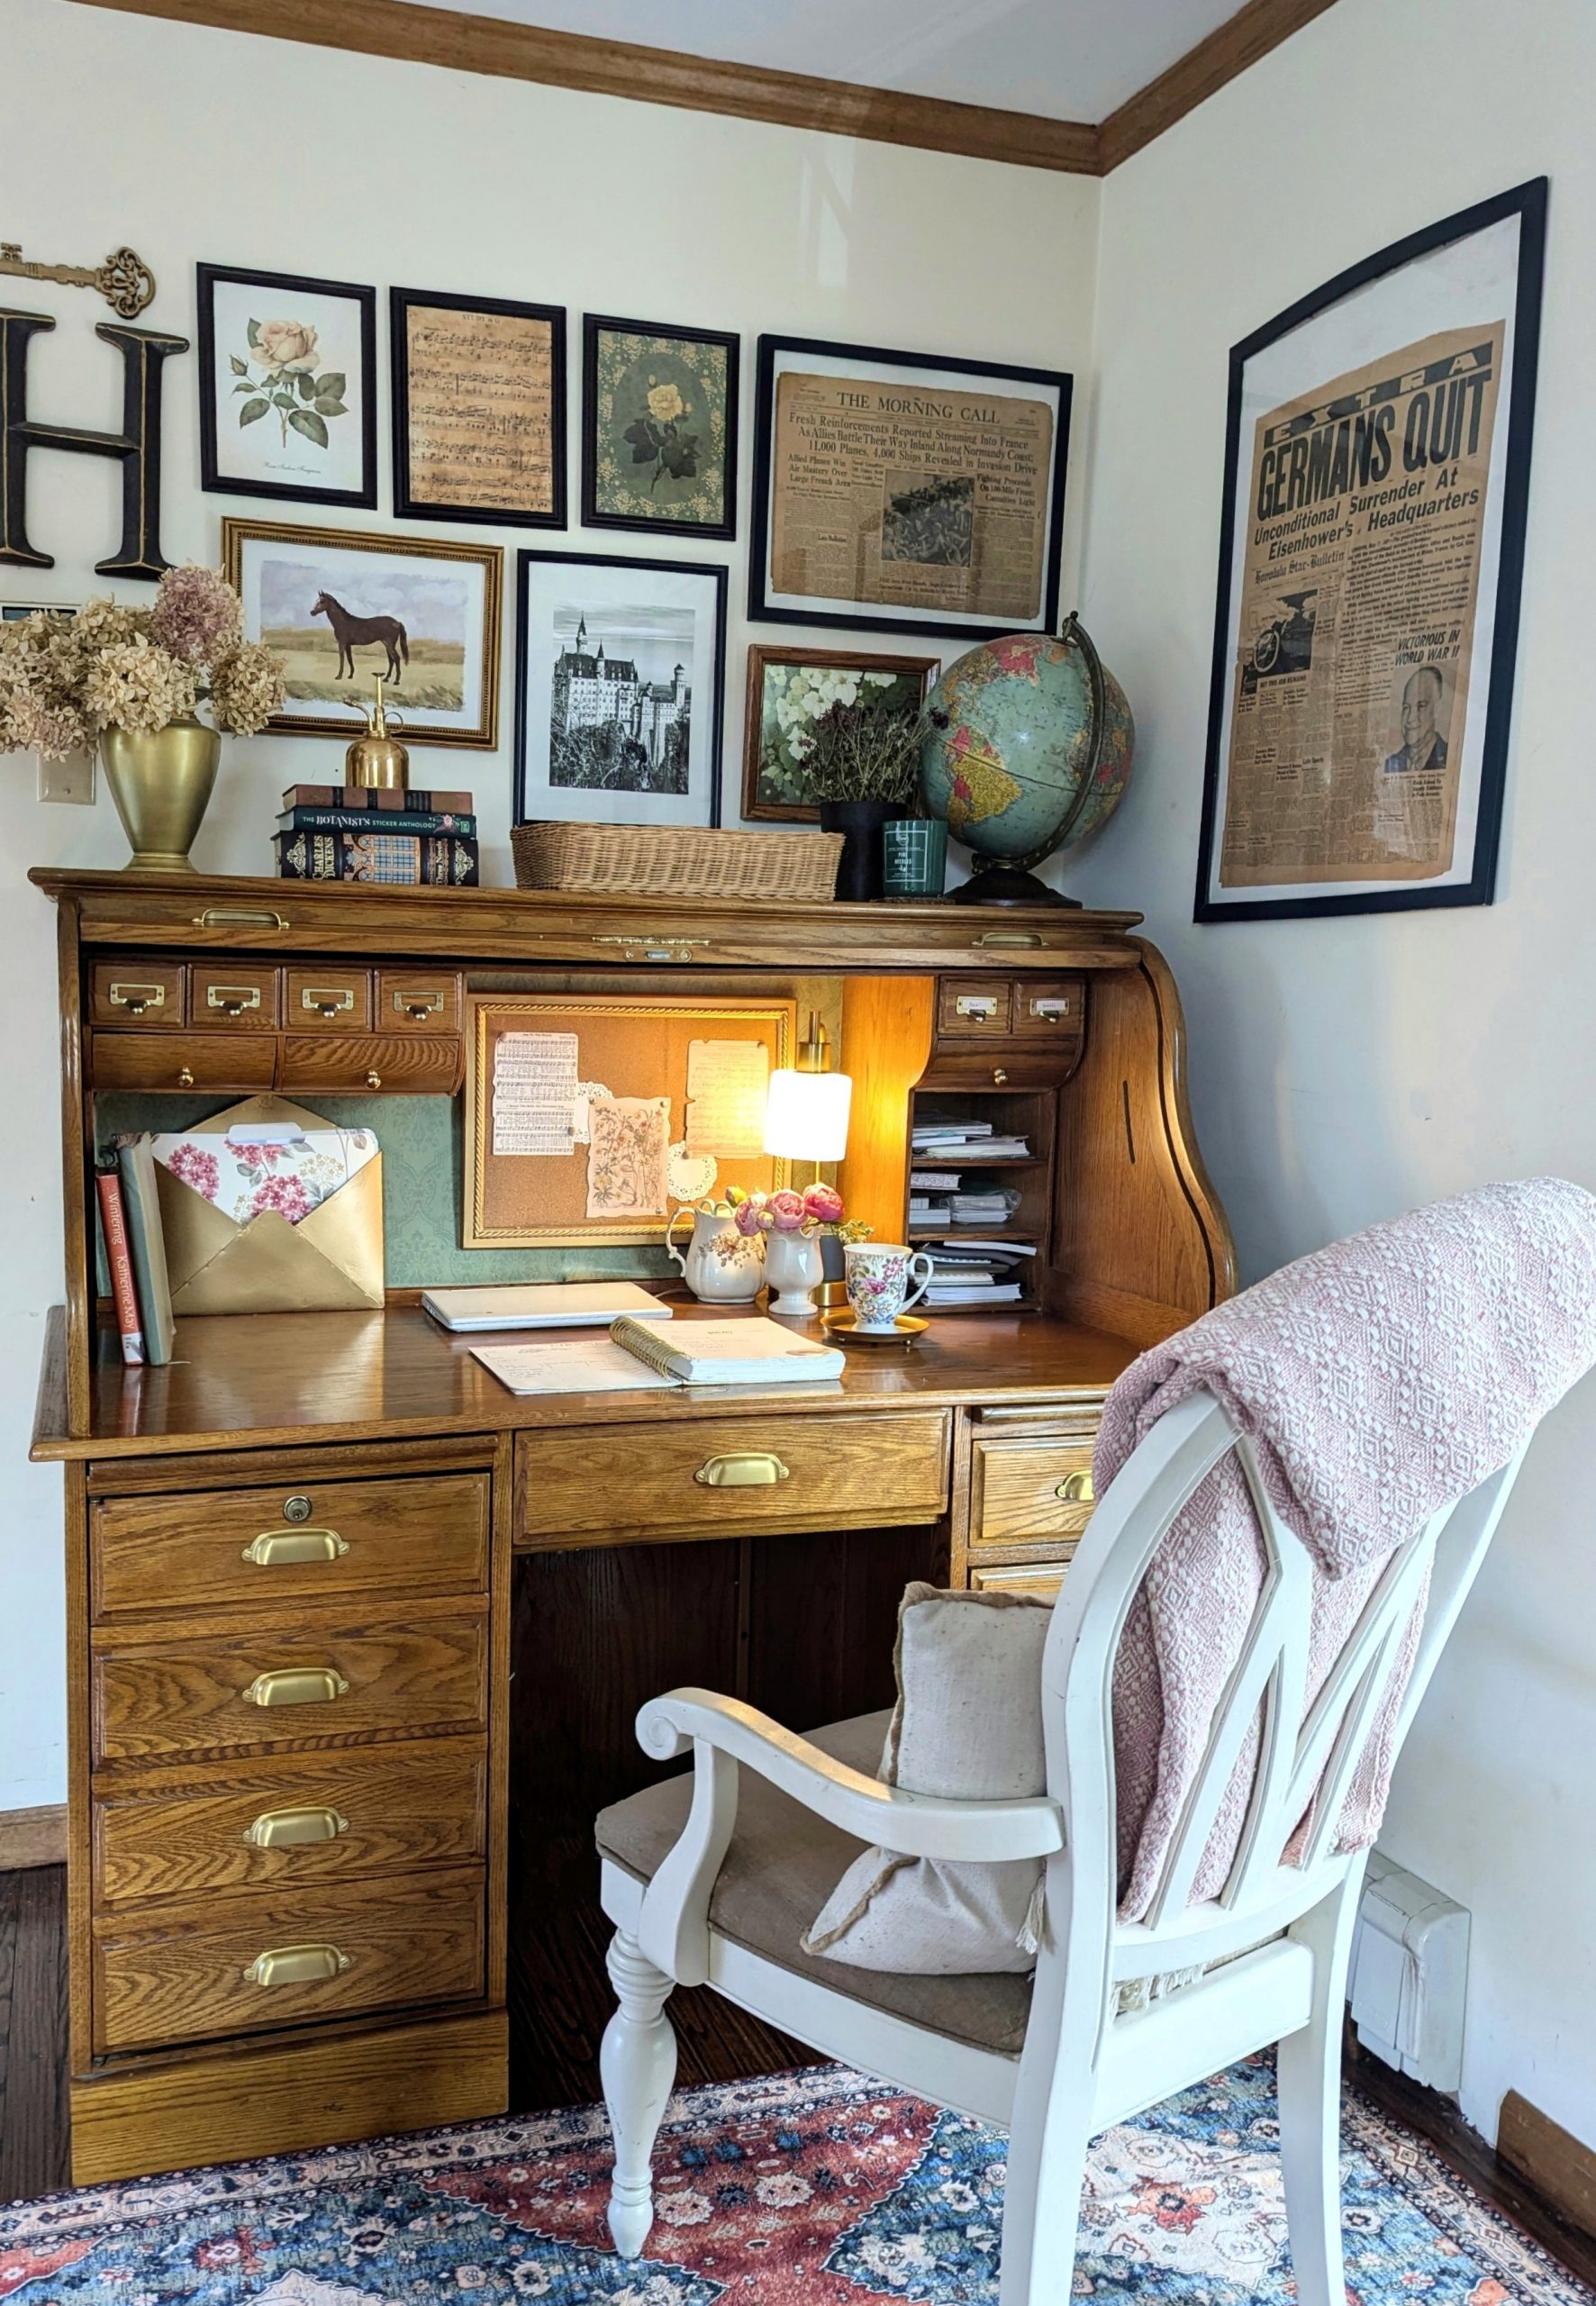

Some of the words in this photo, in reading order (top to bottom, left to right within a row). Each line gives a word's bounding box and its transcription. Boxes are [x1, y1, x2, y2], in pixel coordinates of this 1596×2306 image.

[837, 392, 870, 409] THE
[877, 396, 953, 419] MORNING
[960, 407, 1000, 423] CALL
[1273, 352, 1478, 443] EXTRA
[0, 307, 190, 582] H
[789, 412, 816, 425] Fresh
[820, 415, 889, 434] Reinforcements
[893, 424, 932, 440] Reported
[935, 427, 977, 445] Streaming
[981, 433, 997, 447] Into
[1000, 436, 1029, 449] France
[798, 426, 811, 437] As
[812, 427, 837, 440] Allies
[838, 430, 863, 443] Battle
[863, 432, 887, 447] Their
[889, 436, 908, 449] Way
[910, 439, 936, 451] Inland
[938, 442, 962, 456] Along
[963, 445, 1005, 461] Normandy
[1257, 404, 1396, 522] GERMANS
[1402, 368, 1492, 472] QUIT
[831, 468, 848, 477] Over
[899, 451, 921, 464] Ships
[924, 452, 962, 467] Revealed
[966, 458, 974, 468] in
[977, 458, 1011, 472] Invasion
[1014, 462, 1038, 476] Drive
[1255, 502, 1341, 546] Unconditional
[1349, 479, 1425, 515] Surrender
[1435, 467, 1458, 490] At
[1268, 521, 1354, 561] Eisenhower's
[1367, 488, 1479, 531] Headquarters
[1394, 649, 1424, 667] WORLD
[1427, 647, 1449, 661] WAR
[1452, 645, 1460, 658] II
[1398, 631, 1445, 651] VICTORIOUS
[1449, 629, 1461, 643] IN
[398, 821, 436, 829] ANTHOLOGY
[313, 835, 324, 880] CHARLES
[323, 837, 336, 879] DICKENS
[108, 1192, 123, 1245] Wintering
[116, 1255, 131, 1305] Katherine
[123, 1306, 134, 1330] May
